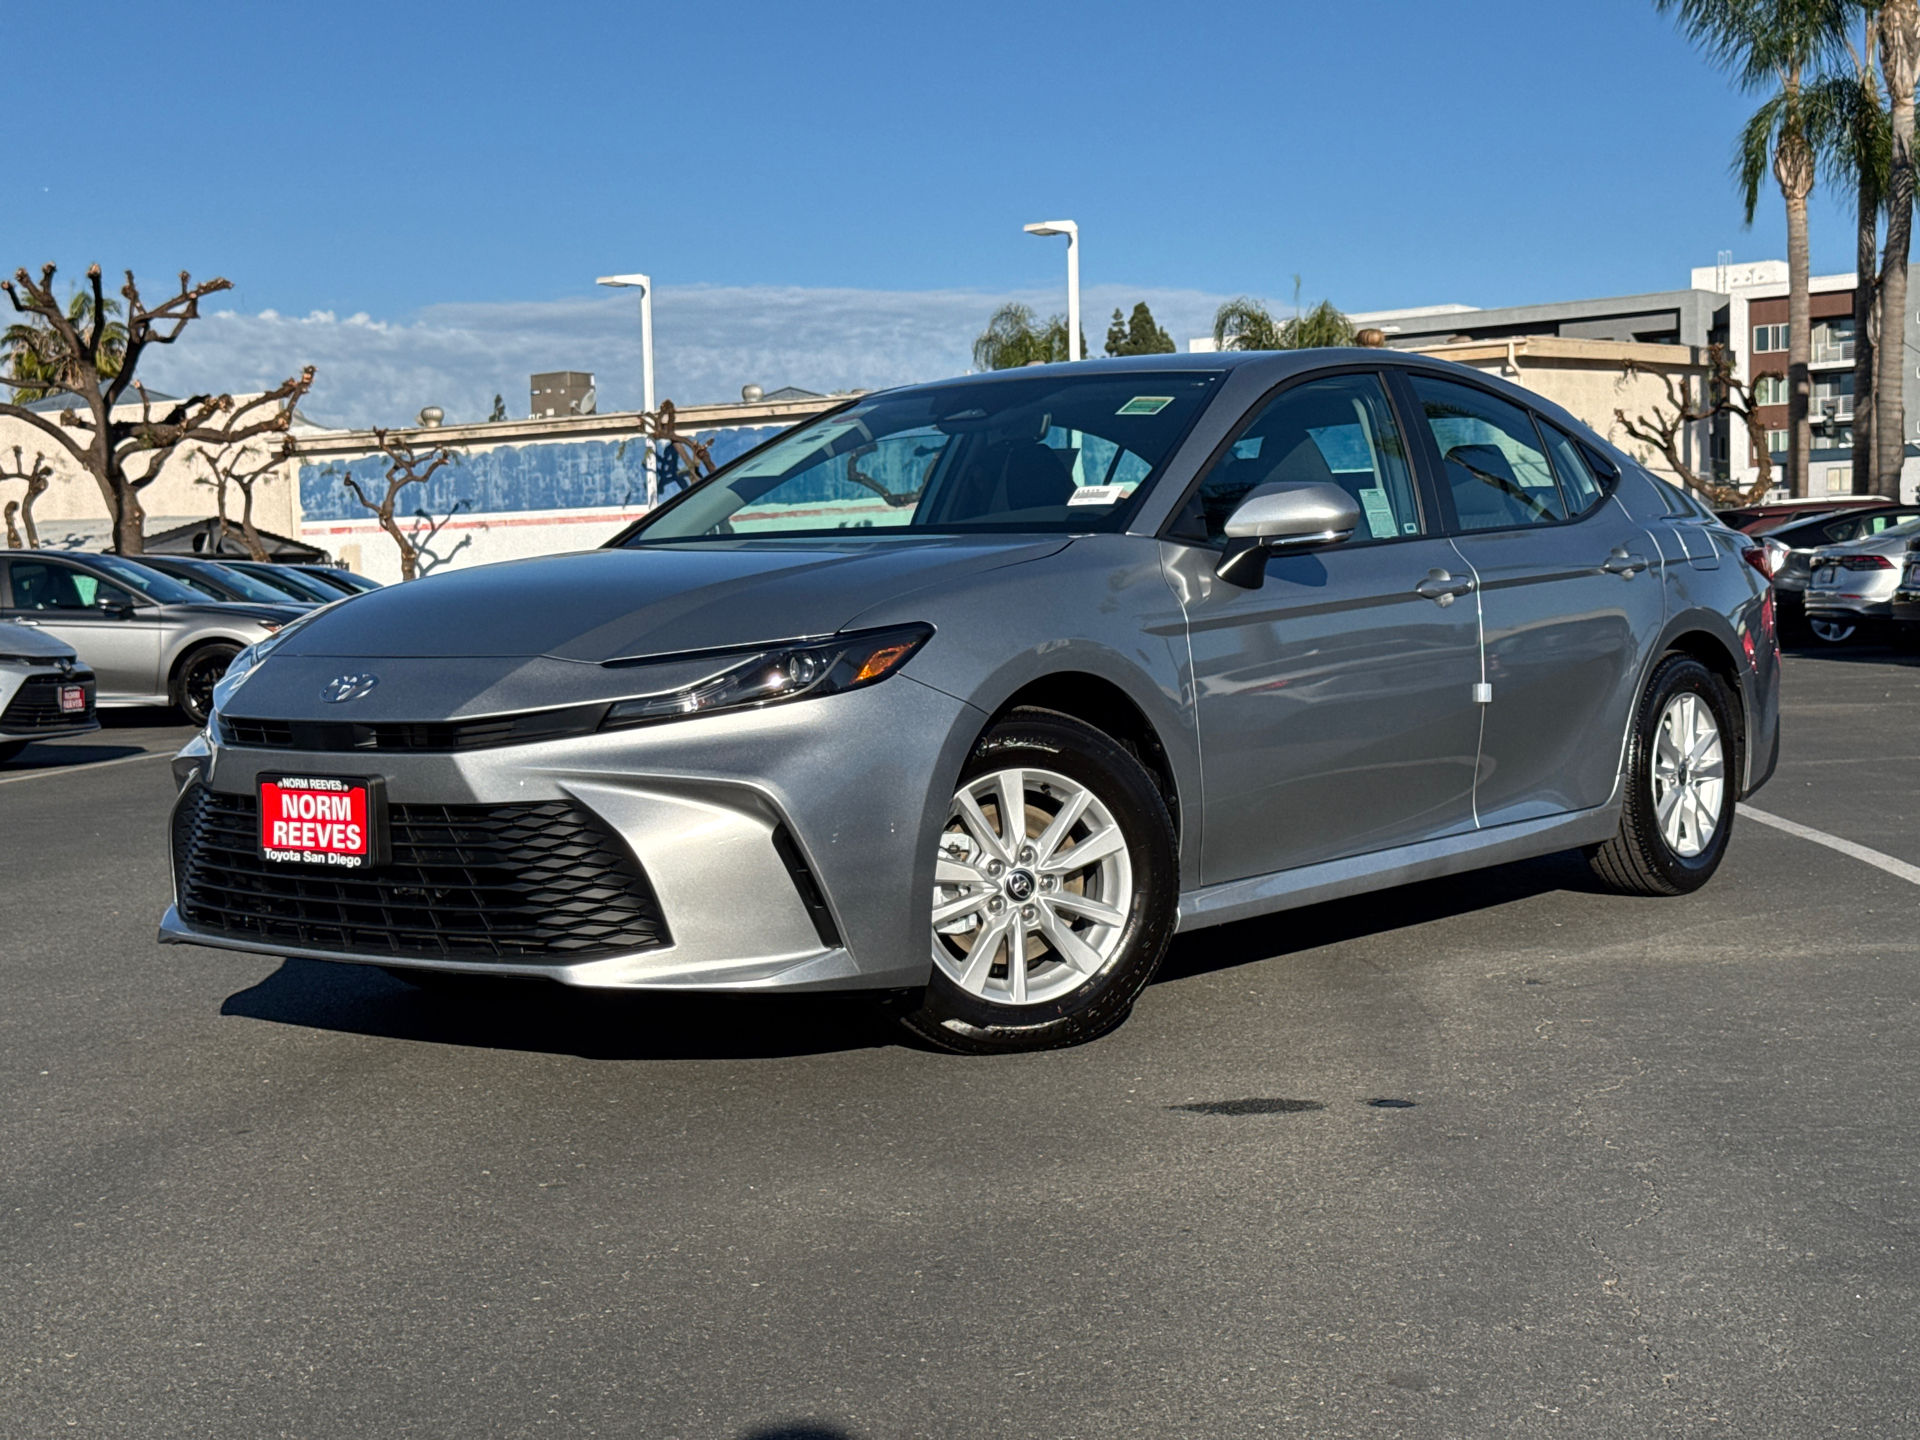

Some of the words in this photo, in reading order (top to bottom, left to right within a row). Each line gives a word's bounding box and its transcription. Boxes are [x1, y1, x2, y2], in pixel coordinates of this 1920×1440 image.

[282, 777, 309, 789] NORM
[310, 778, 342, 791] REEVES
[281, 794, 352, 821] NORM
[273, 820, 361, 850] REEVES
[264, 847, 300, 862] Toyota
[303, 850, 325, 863] San
[328, 852, 361, 868] Diego
